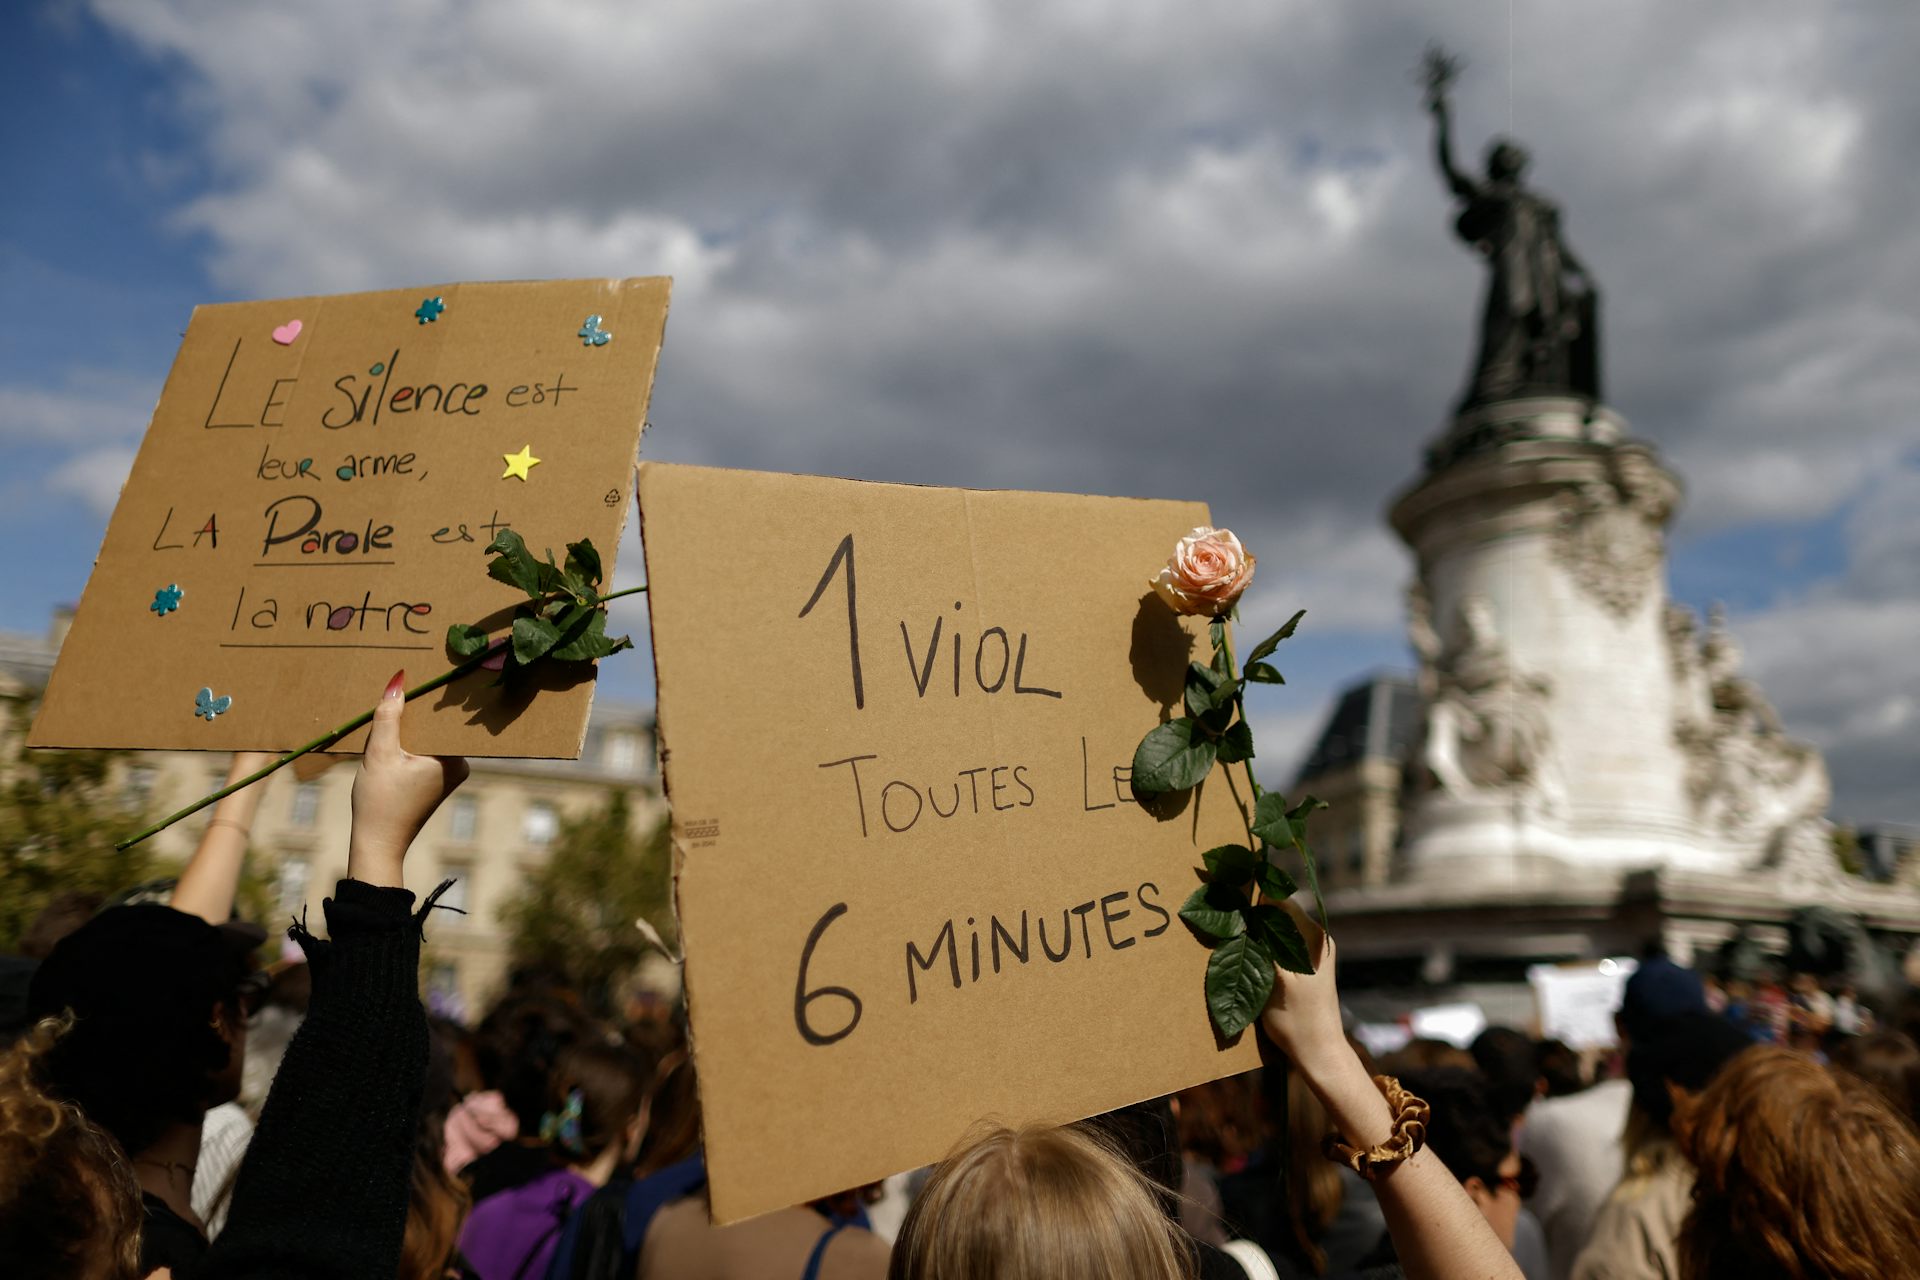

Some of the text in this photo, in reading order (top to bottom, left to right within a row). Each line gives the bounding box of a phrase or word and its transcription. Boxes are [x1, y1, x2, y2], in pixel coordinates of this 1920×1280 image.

[204, 336, 579, 430] LE Silence est
[335, 451, 429, 482] arme,
[153, 494, 512, 557] LA Parole est
[231, 586, 432, 634] la notre
[798, 533, 865, 710] 1
[818, 736, 1144, 838] TOUTES LE
[793, 901, 863, 1047] 6
